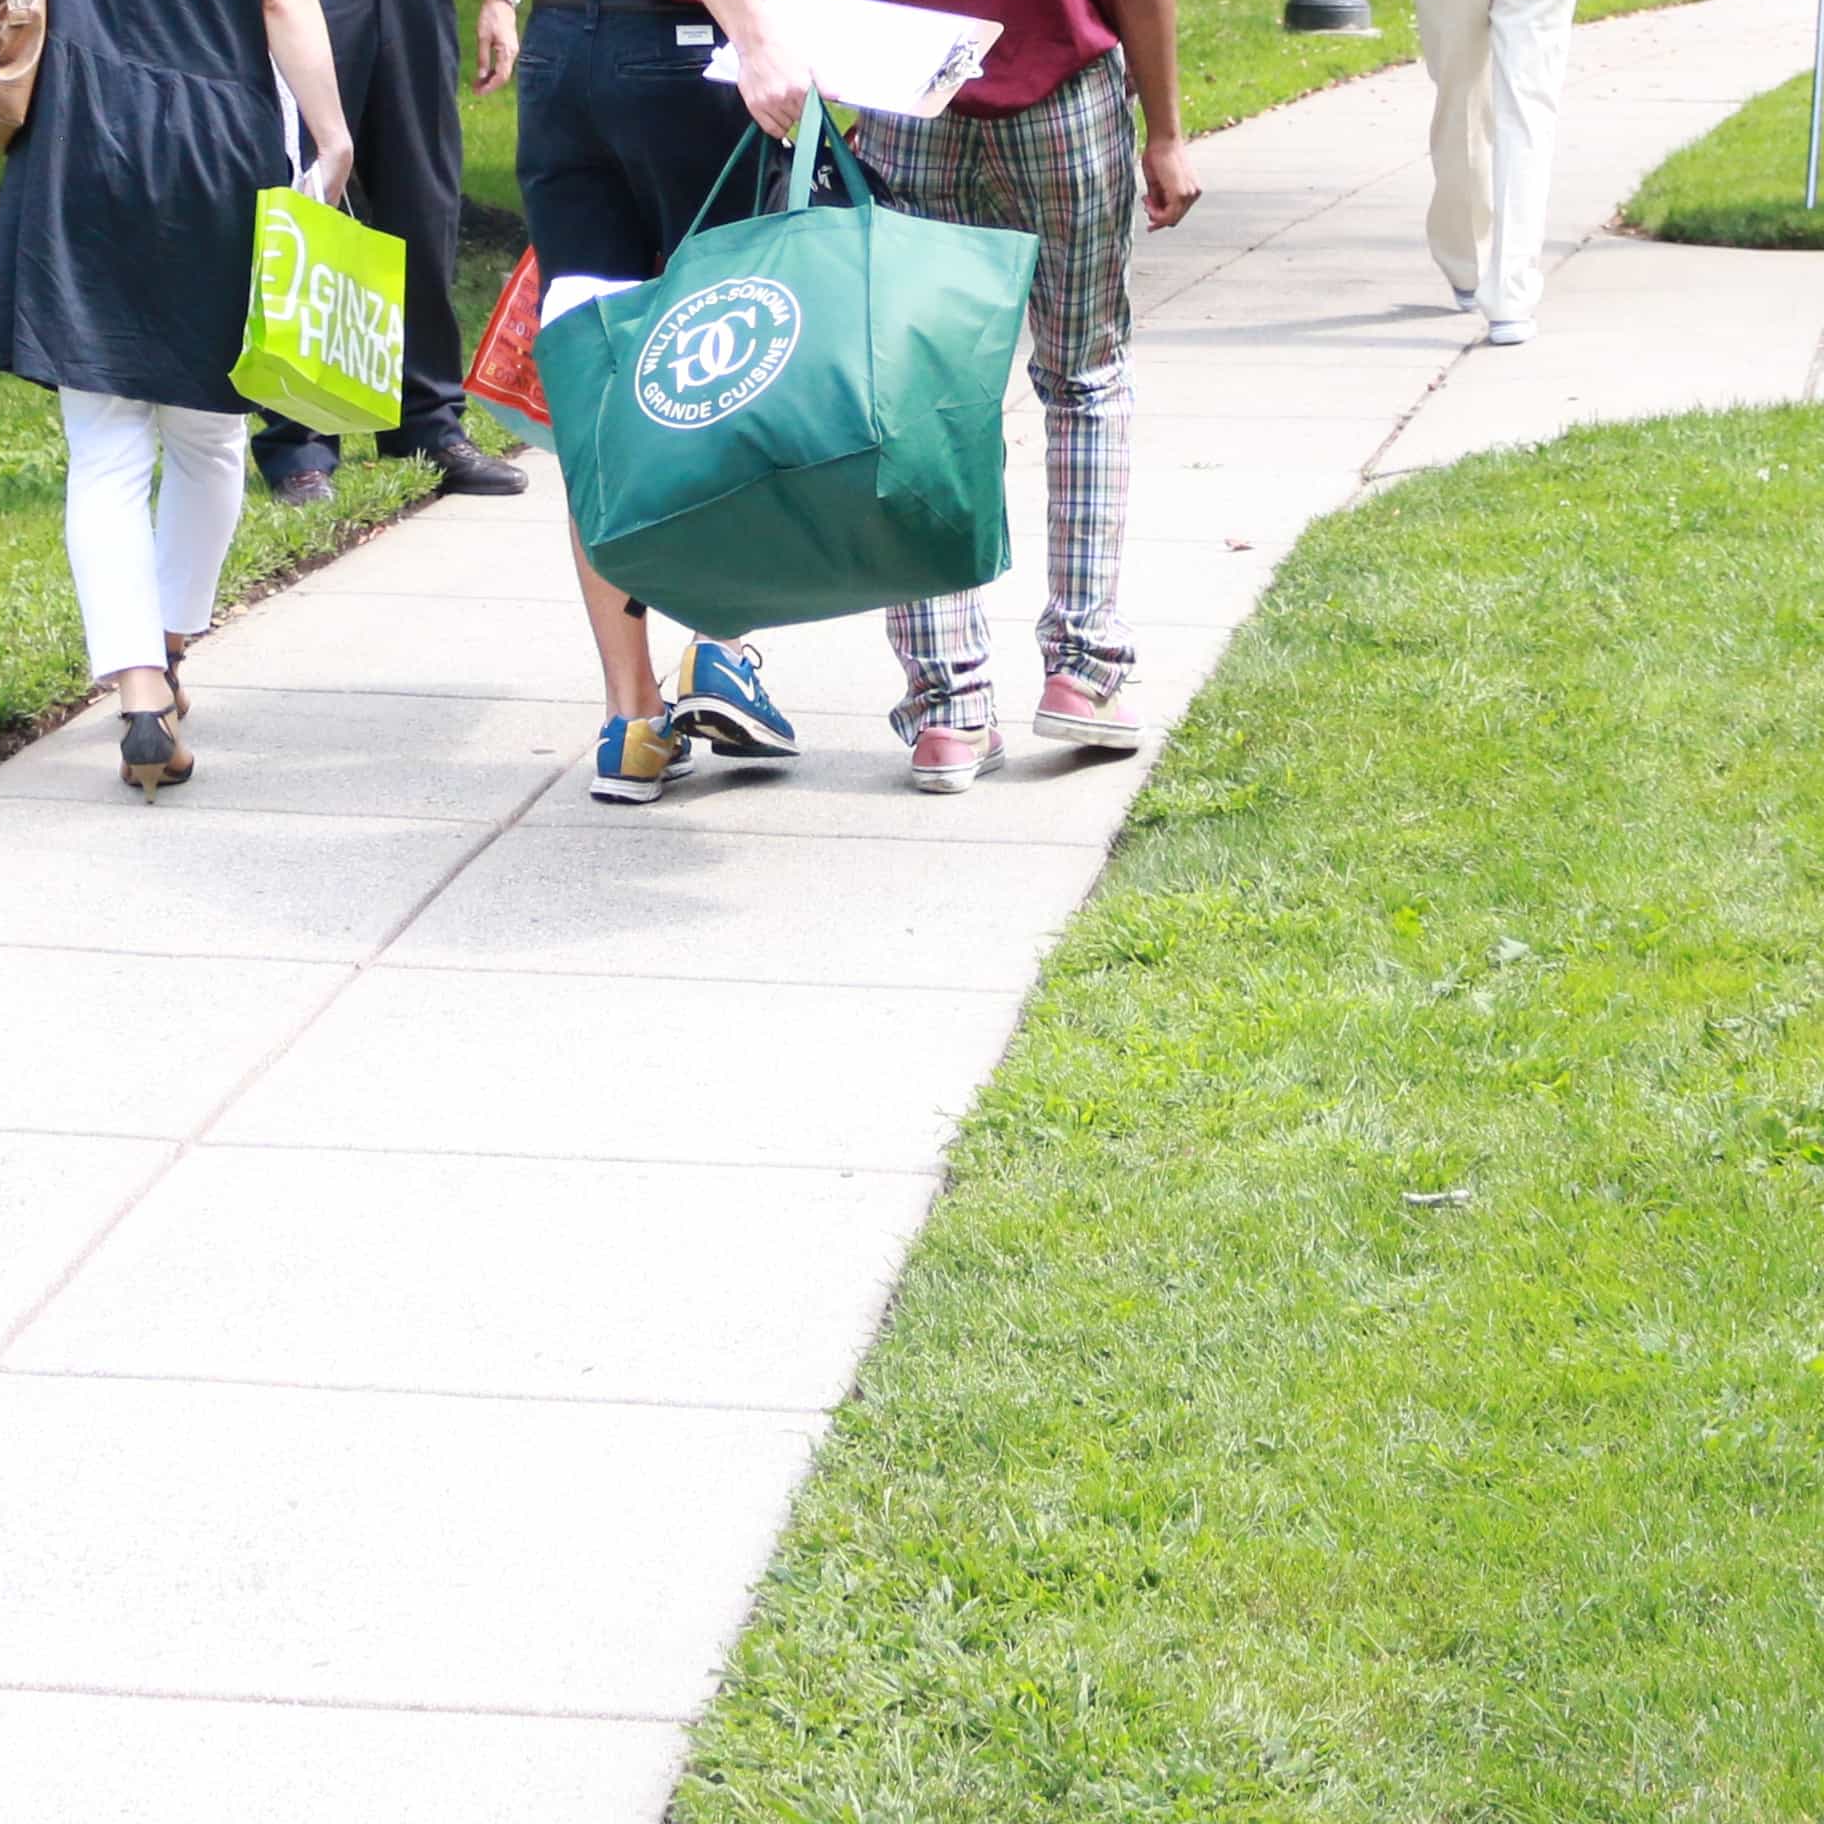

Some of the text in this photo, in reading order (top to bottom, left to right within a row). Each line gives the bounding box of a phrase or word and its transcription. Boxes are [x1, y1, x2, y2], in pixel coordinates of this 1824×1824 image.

[309, 263, 403, 344] GINZA
[641, 282, 792, 377] WILLIAMS-SONOMA
[643, 335, 790, 421] GRANDE CUISINE
